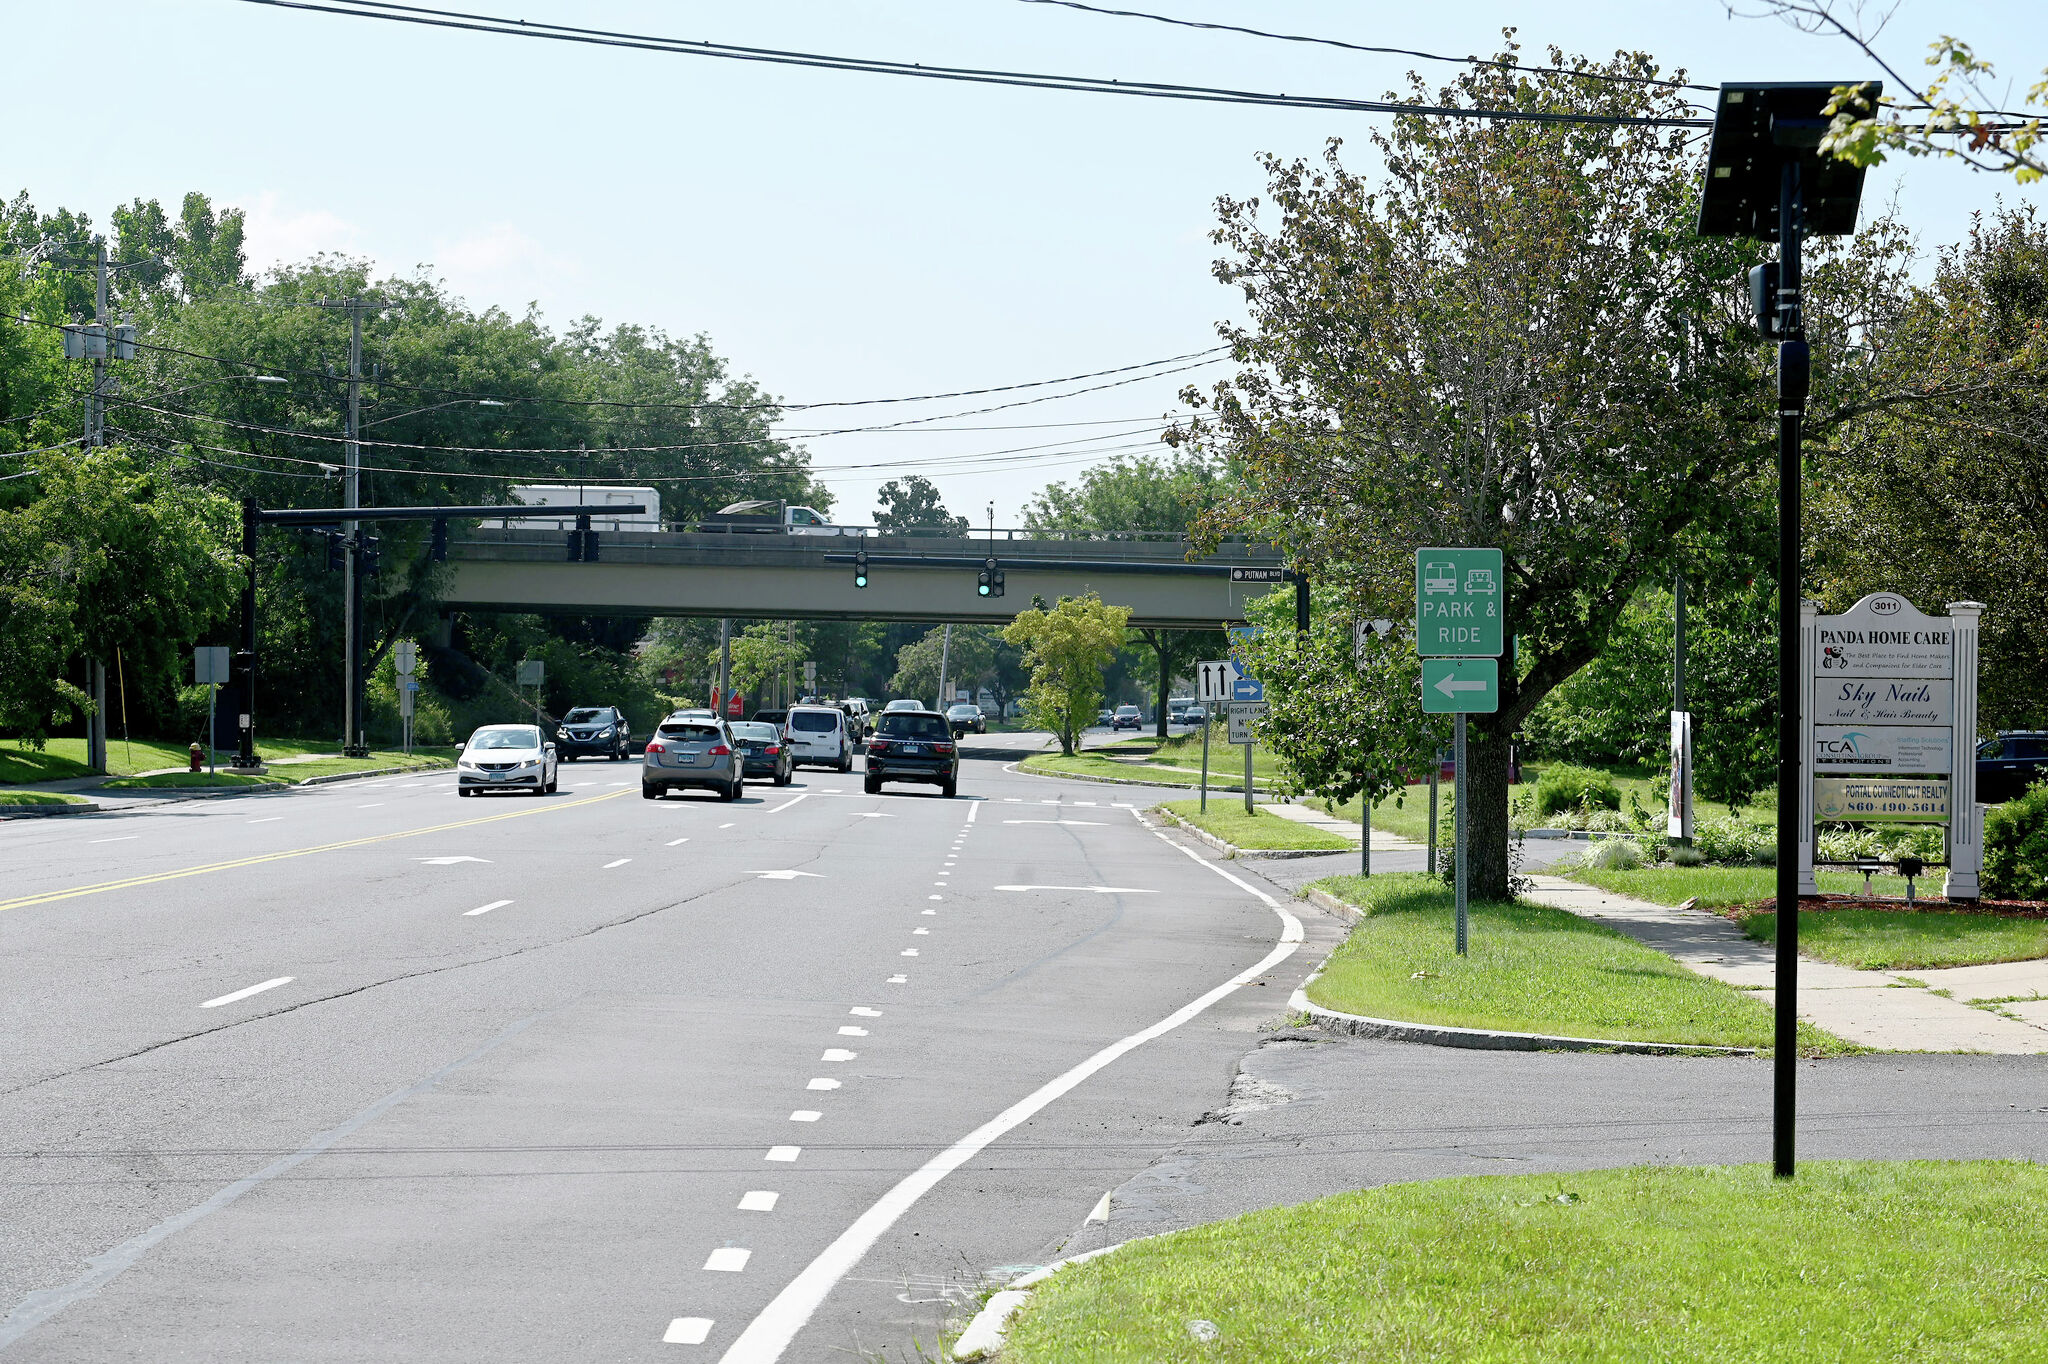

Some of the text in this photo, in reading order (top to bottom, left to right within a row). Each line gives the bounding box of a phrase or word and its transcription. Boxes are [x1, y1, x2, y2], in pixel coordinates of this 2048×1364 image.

[1244, 570, 1268, 579] PUTNAM
[1423, 602, 1496, 617] PARK &
[1874, 602, 1897, 610] 3011
[1439, 627, 1481, 642] RIDE
[1820, 630, 1950, 645] PANDA HOME CARE
[1838, 682, 1931, 709] Sky Nails
[1829, 708, 1938, 722] Nail & Hair Beauty
[1816, 740, 1854, 753] TCA
[1845, 784, 1948, 799] PORTAL CONNECTICUT REALTY
